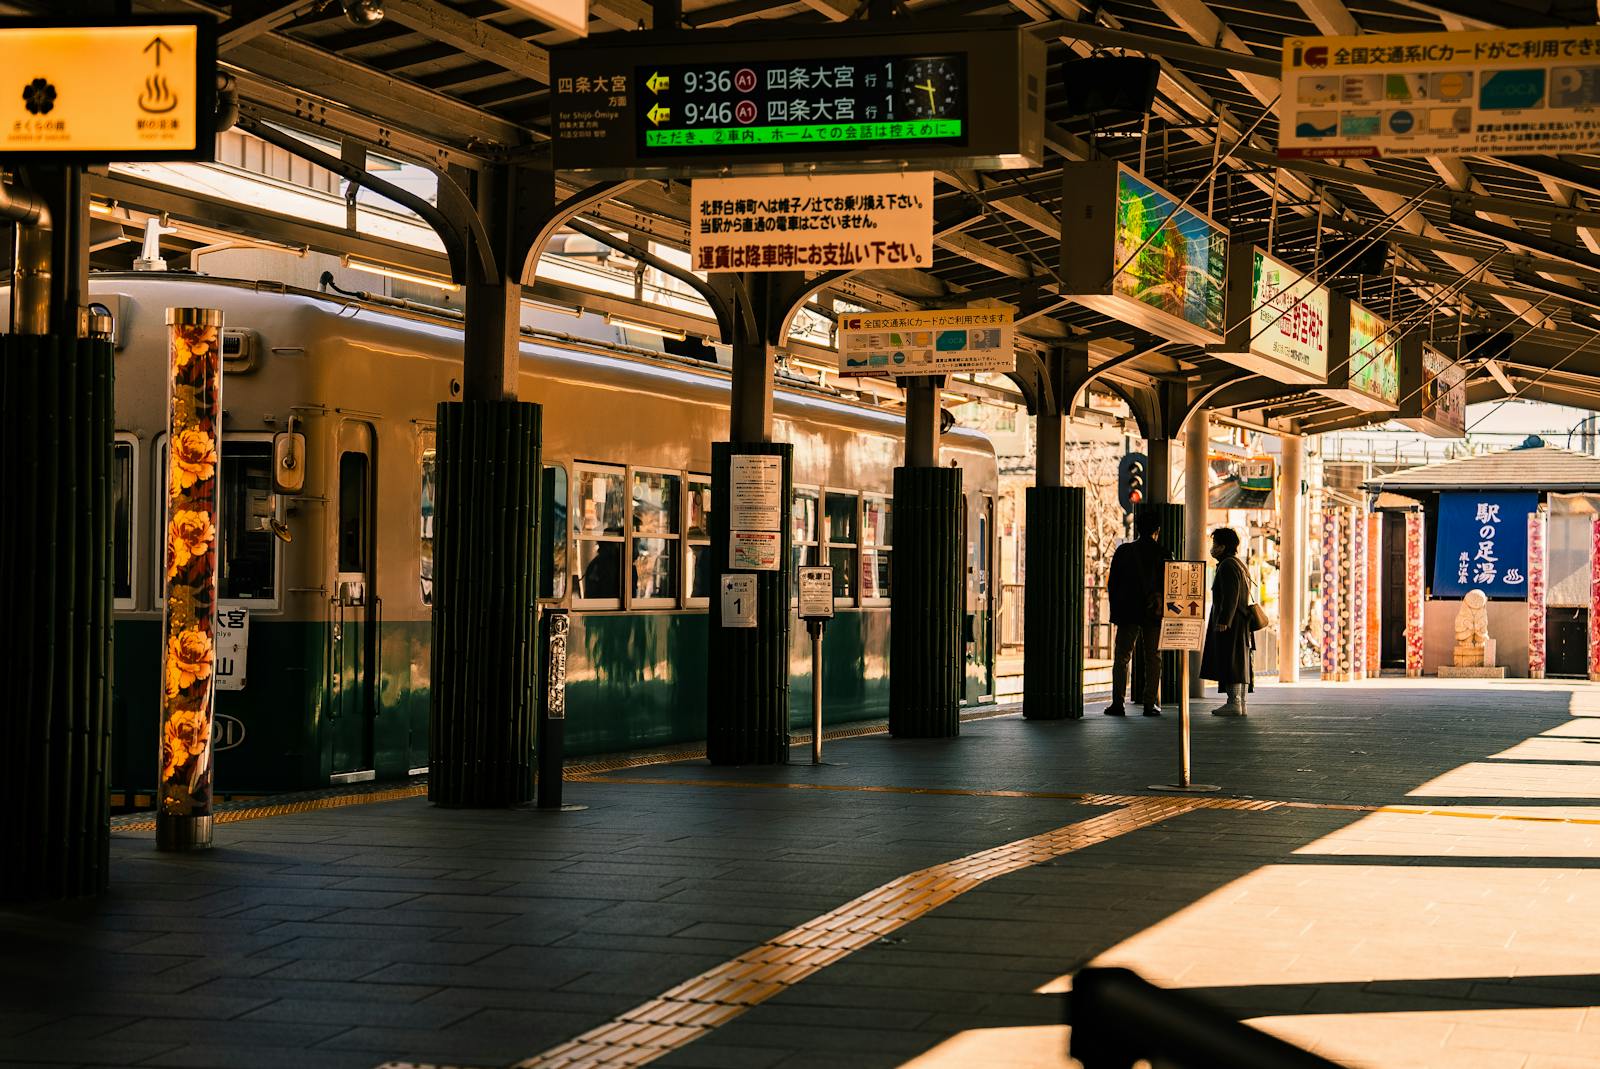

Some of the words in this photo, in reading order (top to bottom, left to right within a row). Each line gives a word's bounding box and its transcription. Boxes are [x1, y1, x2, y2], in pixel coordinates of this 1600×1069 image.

[558, 75, 627, 94] 四条大宮
[683, 70, 732, 93] 9:36
[767, 65, 855, 91] 四条大宮
[865, 73, 878, 88] 行
[608, 95, 627, 107] 方面
[684, 101, 733, 124] 9:46
[767, 97, 856, 122] 四条大宮
[865, 105, 878, 120] 行
[700, 214, 878, 234] 当駅から直通の電車はございません。
[698, 241, 923, 269] 運賃は降車時にお支払い下さい。
[1473, 502, 1501, 584] 駅の足湯
[733, 597, 741, 615] 1
